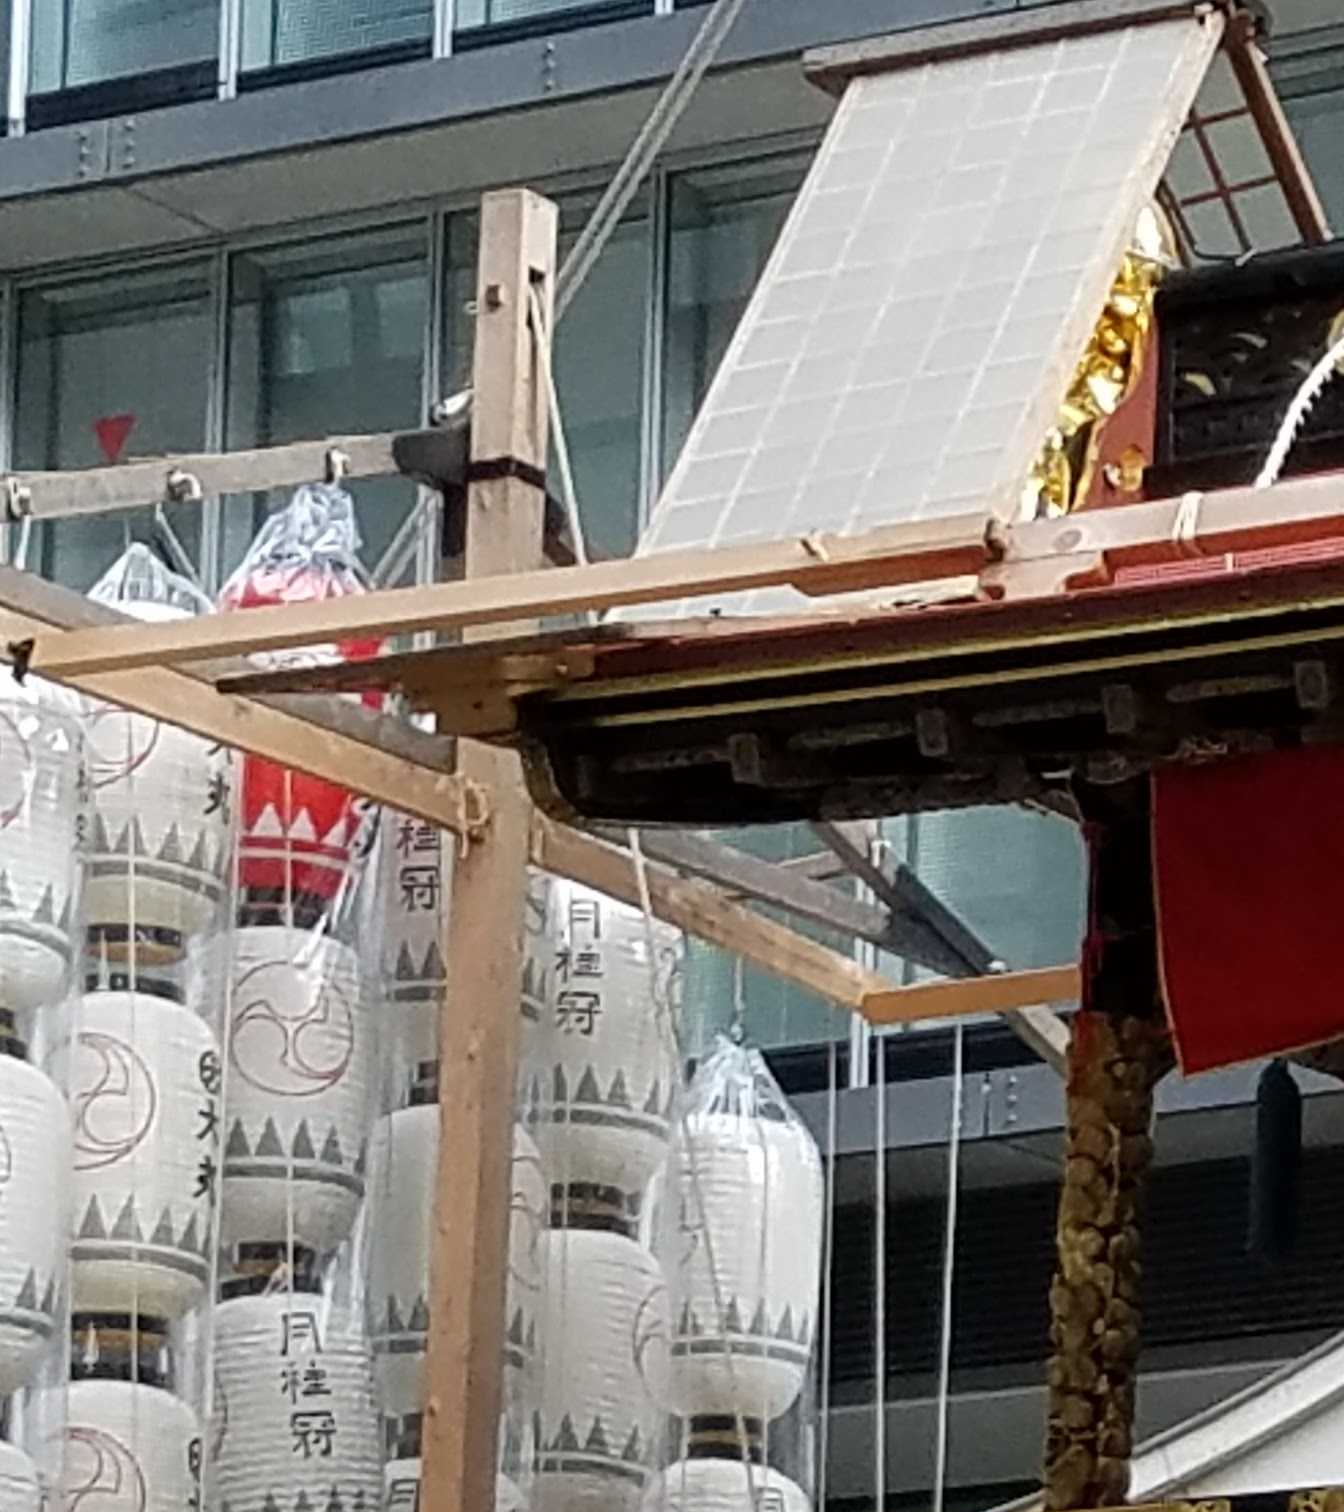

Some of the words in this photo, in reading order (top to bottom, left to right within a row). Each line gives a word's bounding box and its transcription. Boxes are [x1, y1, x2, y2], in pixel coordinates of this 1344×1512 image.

[397, 818, 440, 913] 桂冠
[554, 898, 604, 1035] 月桂冠
[279, 1311, 338, 1459] 月桂冠
